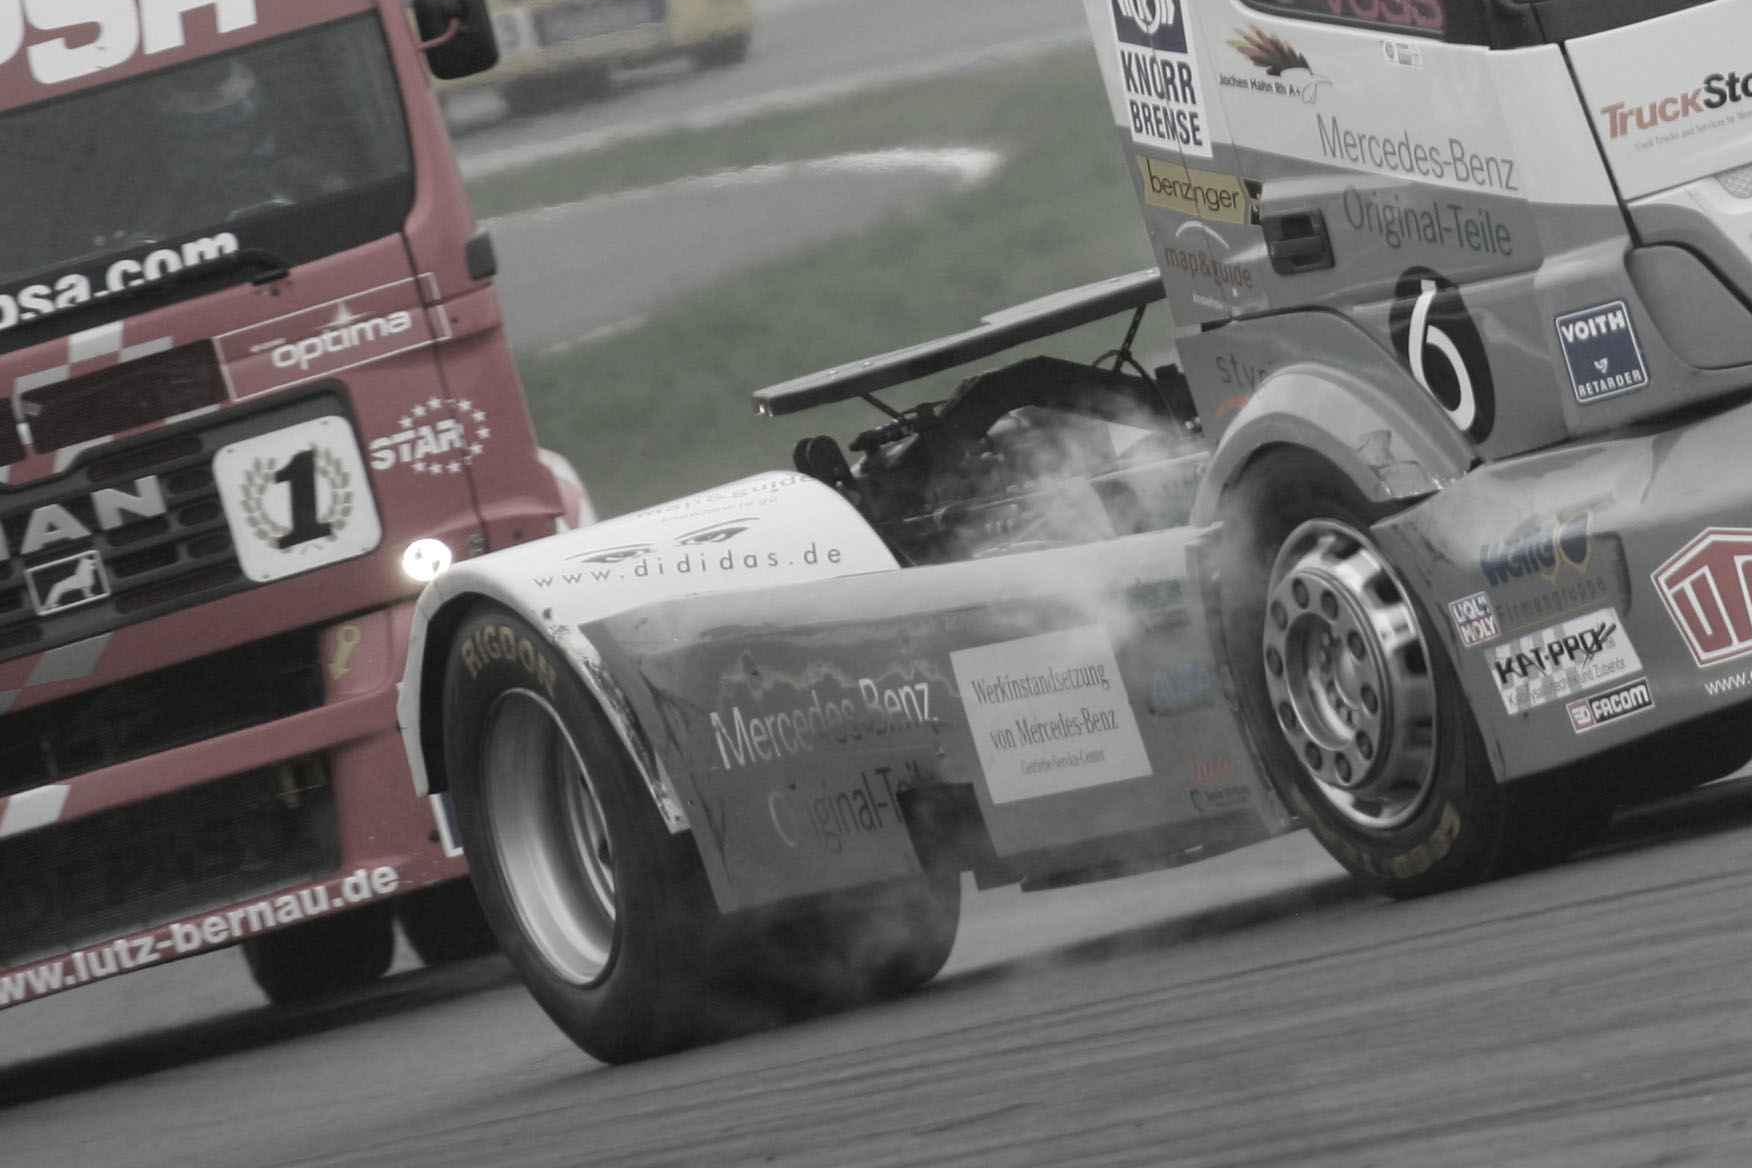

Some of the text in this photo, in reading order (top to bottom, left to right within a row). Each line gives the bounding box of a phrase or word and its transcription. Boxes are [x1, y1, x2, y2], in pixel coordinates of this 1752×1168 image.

[1120, 49, 1198, 106] KNORR
[1316, 112, 1520, 192] Mercedes-Benz
[1146, 158, 1240, 212] benznger
[1343, 185, 1512, 257] Original-Teile
[271, 310, 413, 371] optima
[1561, 310, 1627, 343] VOITH
[1408, 279, 1476, 431] 6
[1577, 369, 1643, 398] RETARDER
[369, 418, 466, 471] STAR
[274, 449, 332, 549] 1
[534, 543, 843, 589] www.dididas.de
[971, 663, 1111, 705] Werkinstandsetzung
[1591, 683, 1650, 719] FACOM
[989, 707, 1120, 751] von Mercedes-Benz
